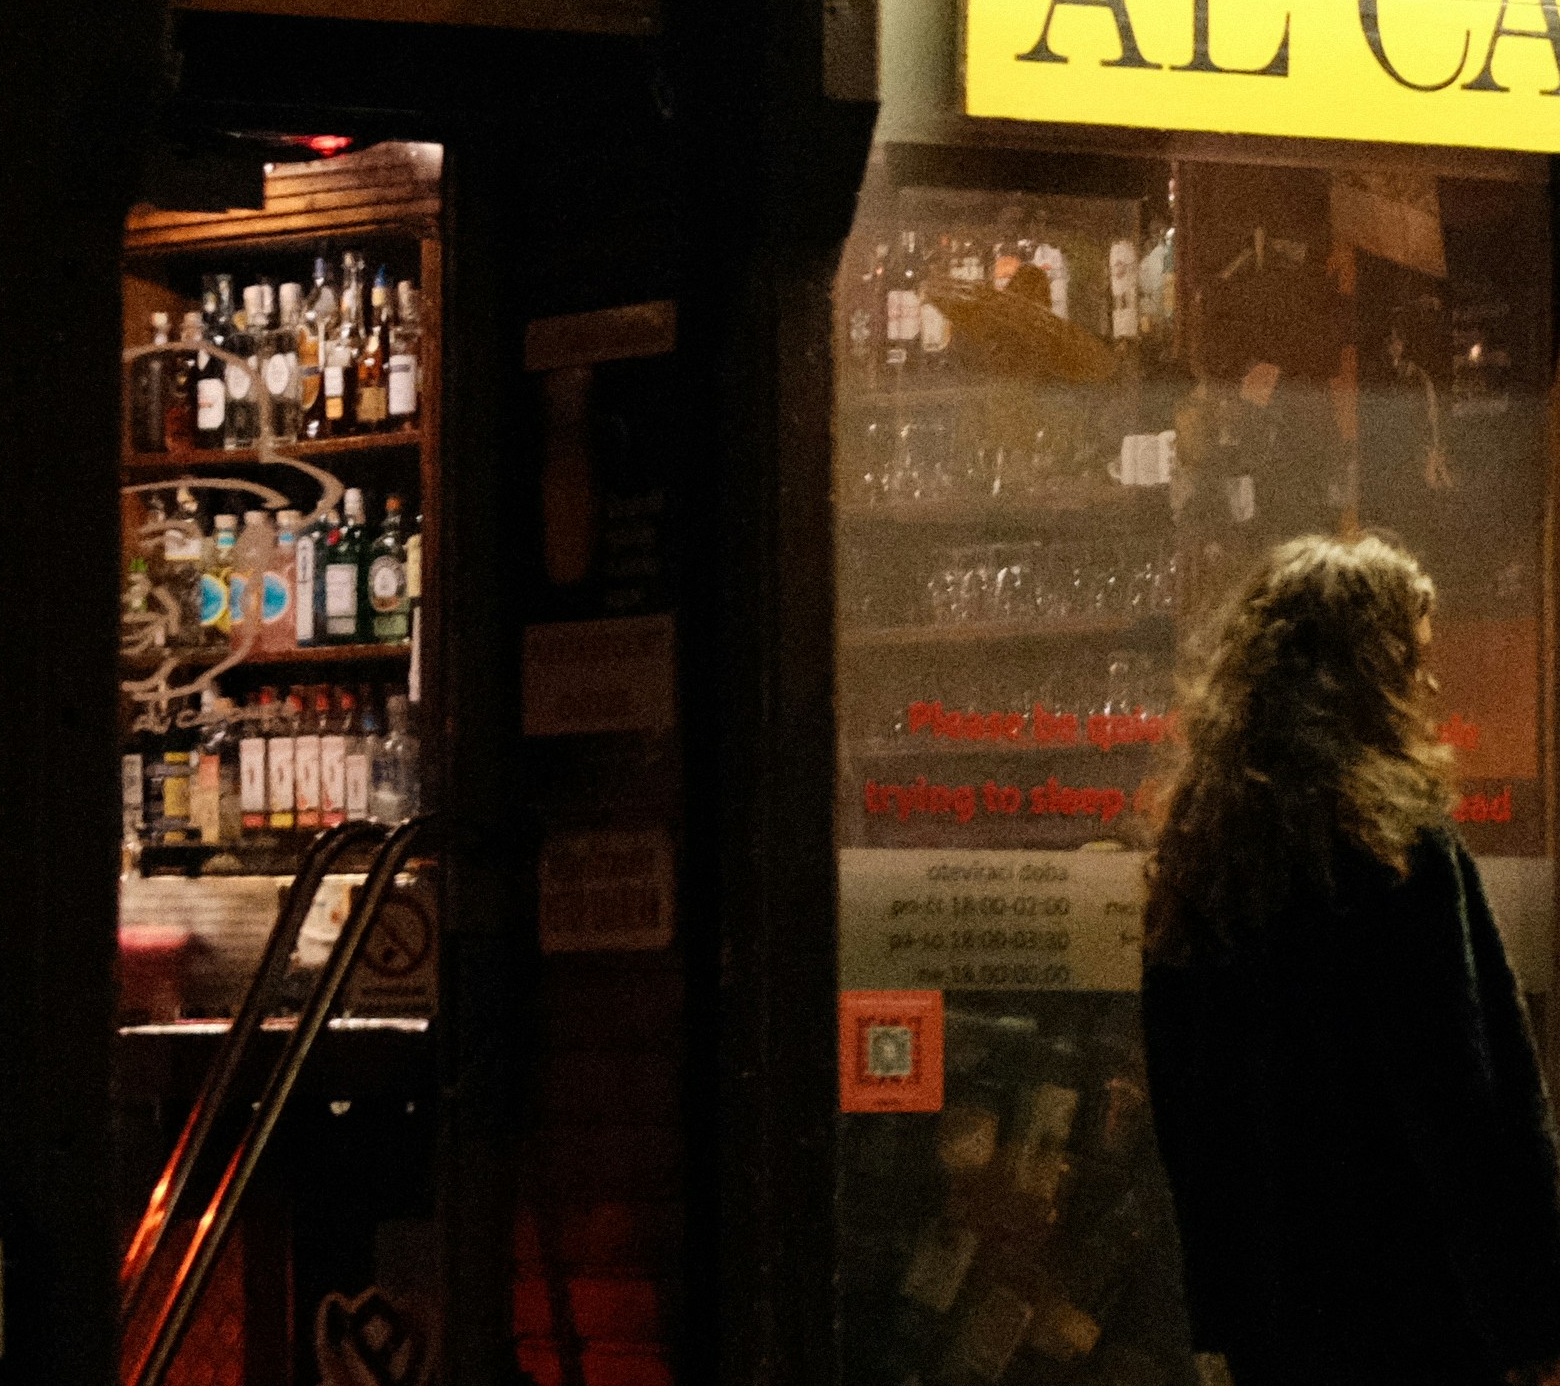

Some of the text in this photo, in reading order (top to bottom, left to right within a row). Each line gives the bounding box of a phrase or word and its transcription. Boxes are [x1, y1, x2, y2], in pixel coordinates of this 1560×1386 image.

[908, 700, 1024, 740] Please
[864, 776, 976, 824] trying
[983, 780, 1022, 814] to
